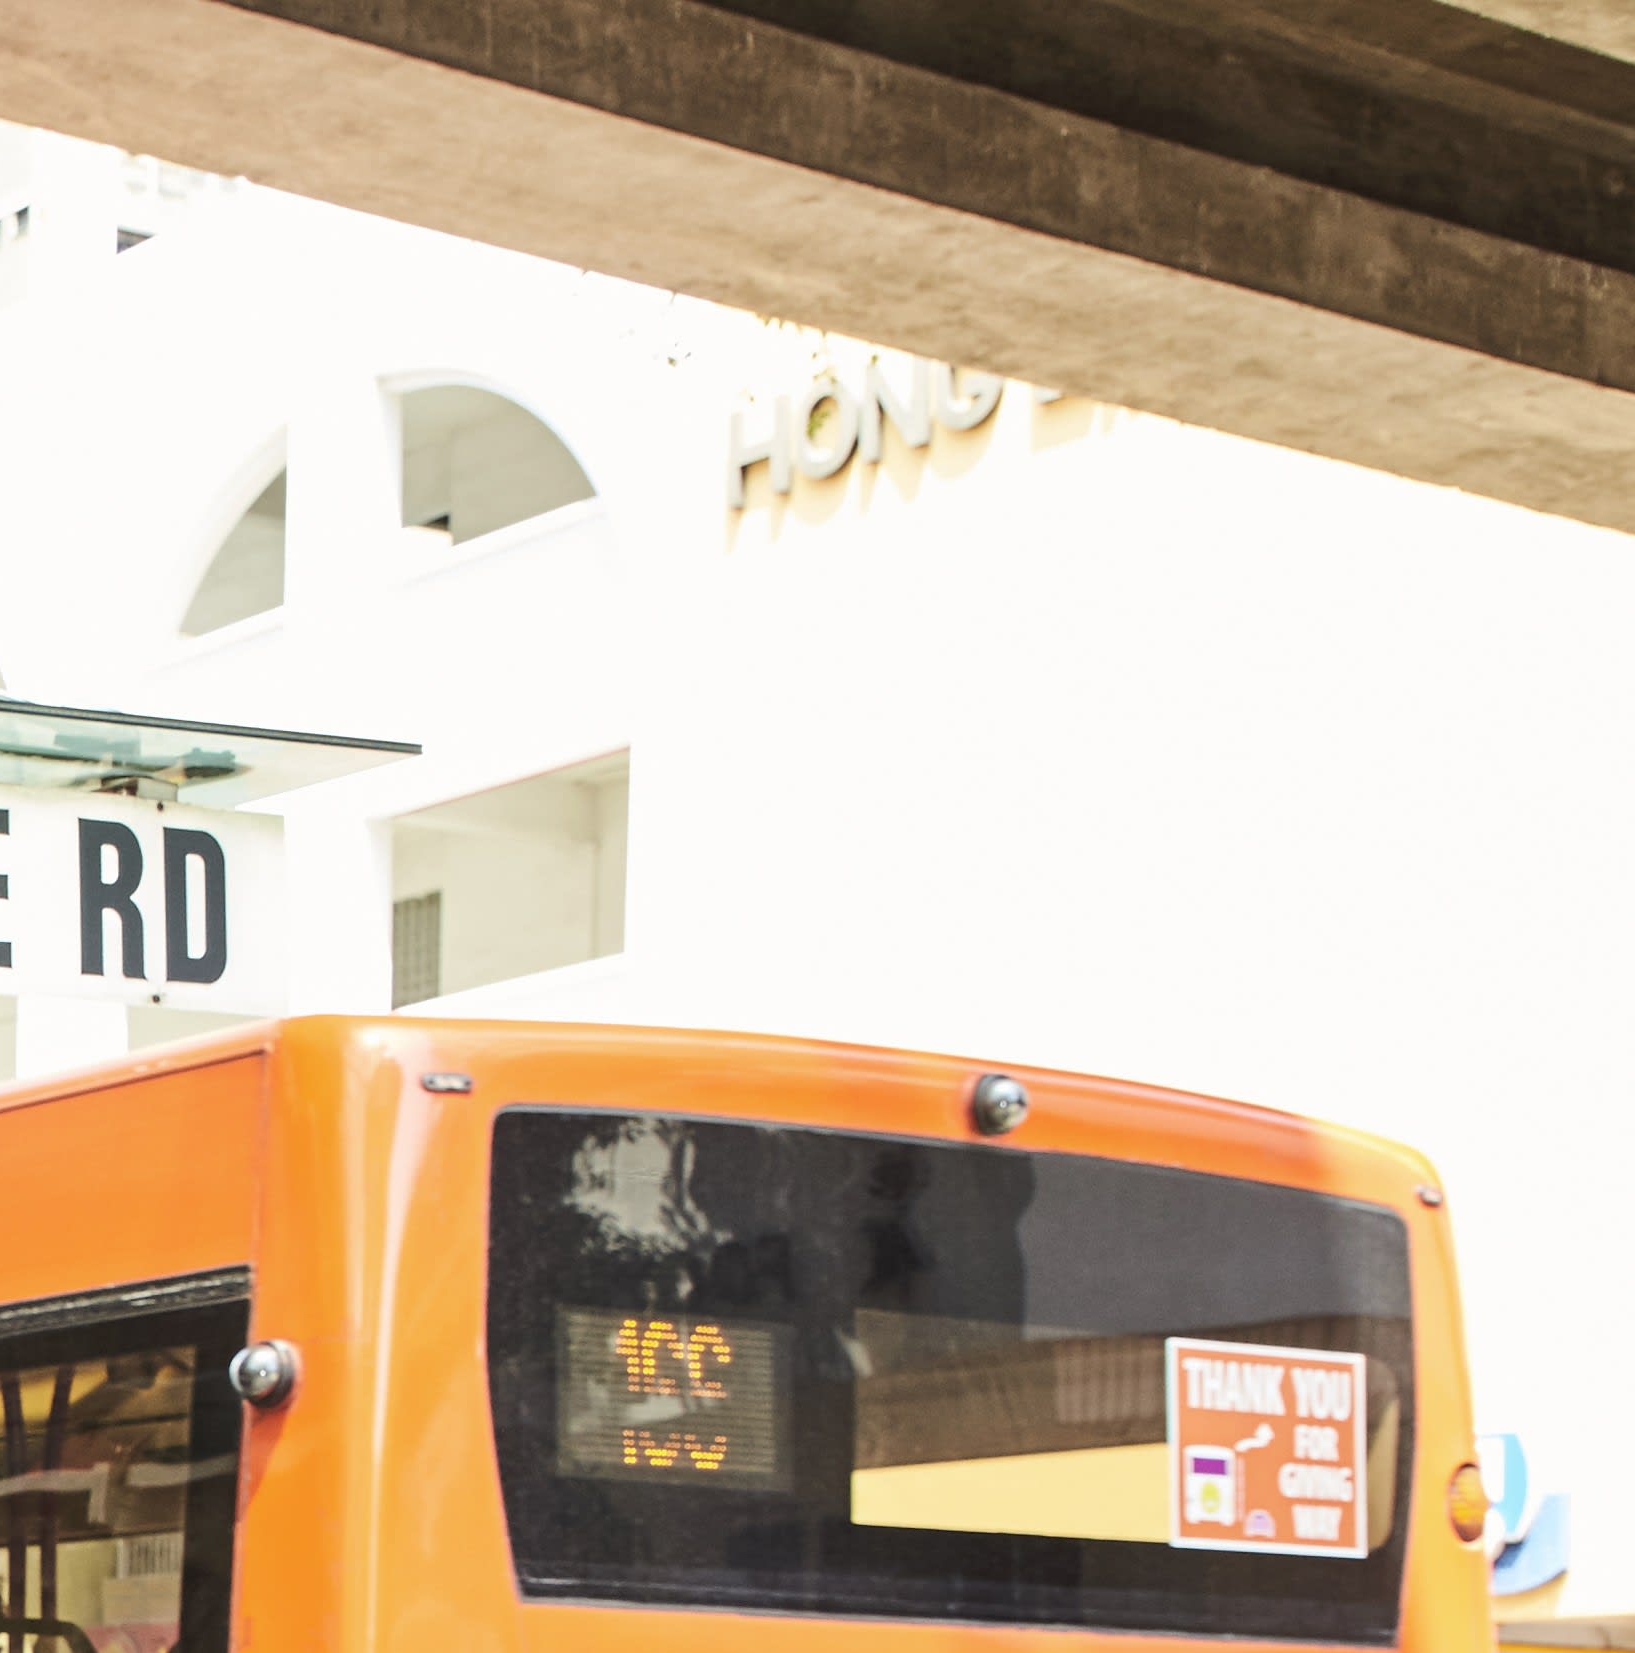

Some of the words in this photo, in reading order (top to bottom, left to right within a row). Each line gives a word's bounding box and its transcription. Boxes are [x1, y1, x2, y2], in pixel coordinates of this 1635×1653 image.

[730, 352, 1007, 510] HONG
[78, 818, 227, 984] RD
[1182, 1356, 1287, 1417] THANK
[1290, 1366, 1353, 1422] YOU
[1293, 1423, 1340, 1462] FOR
